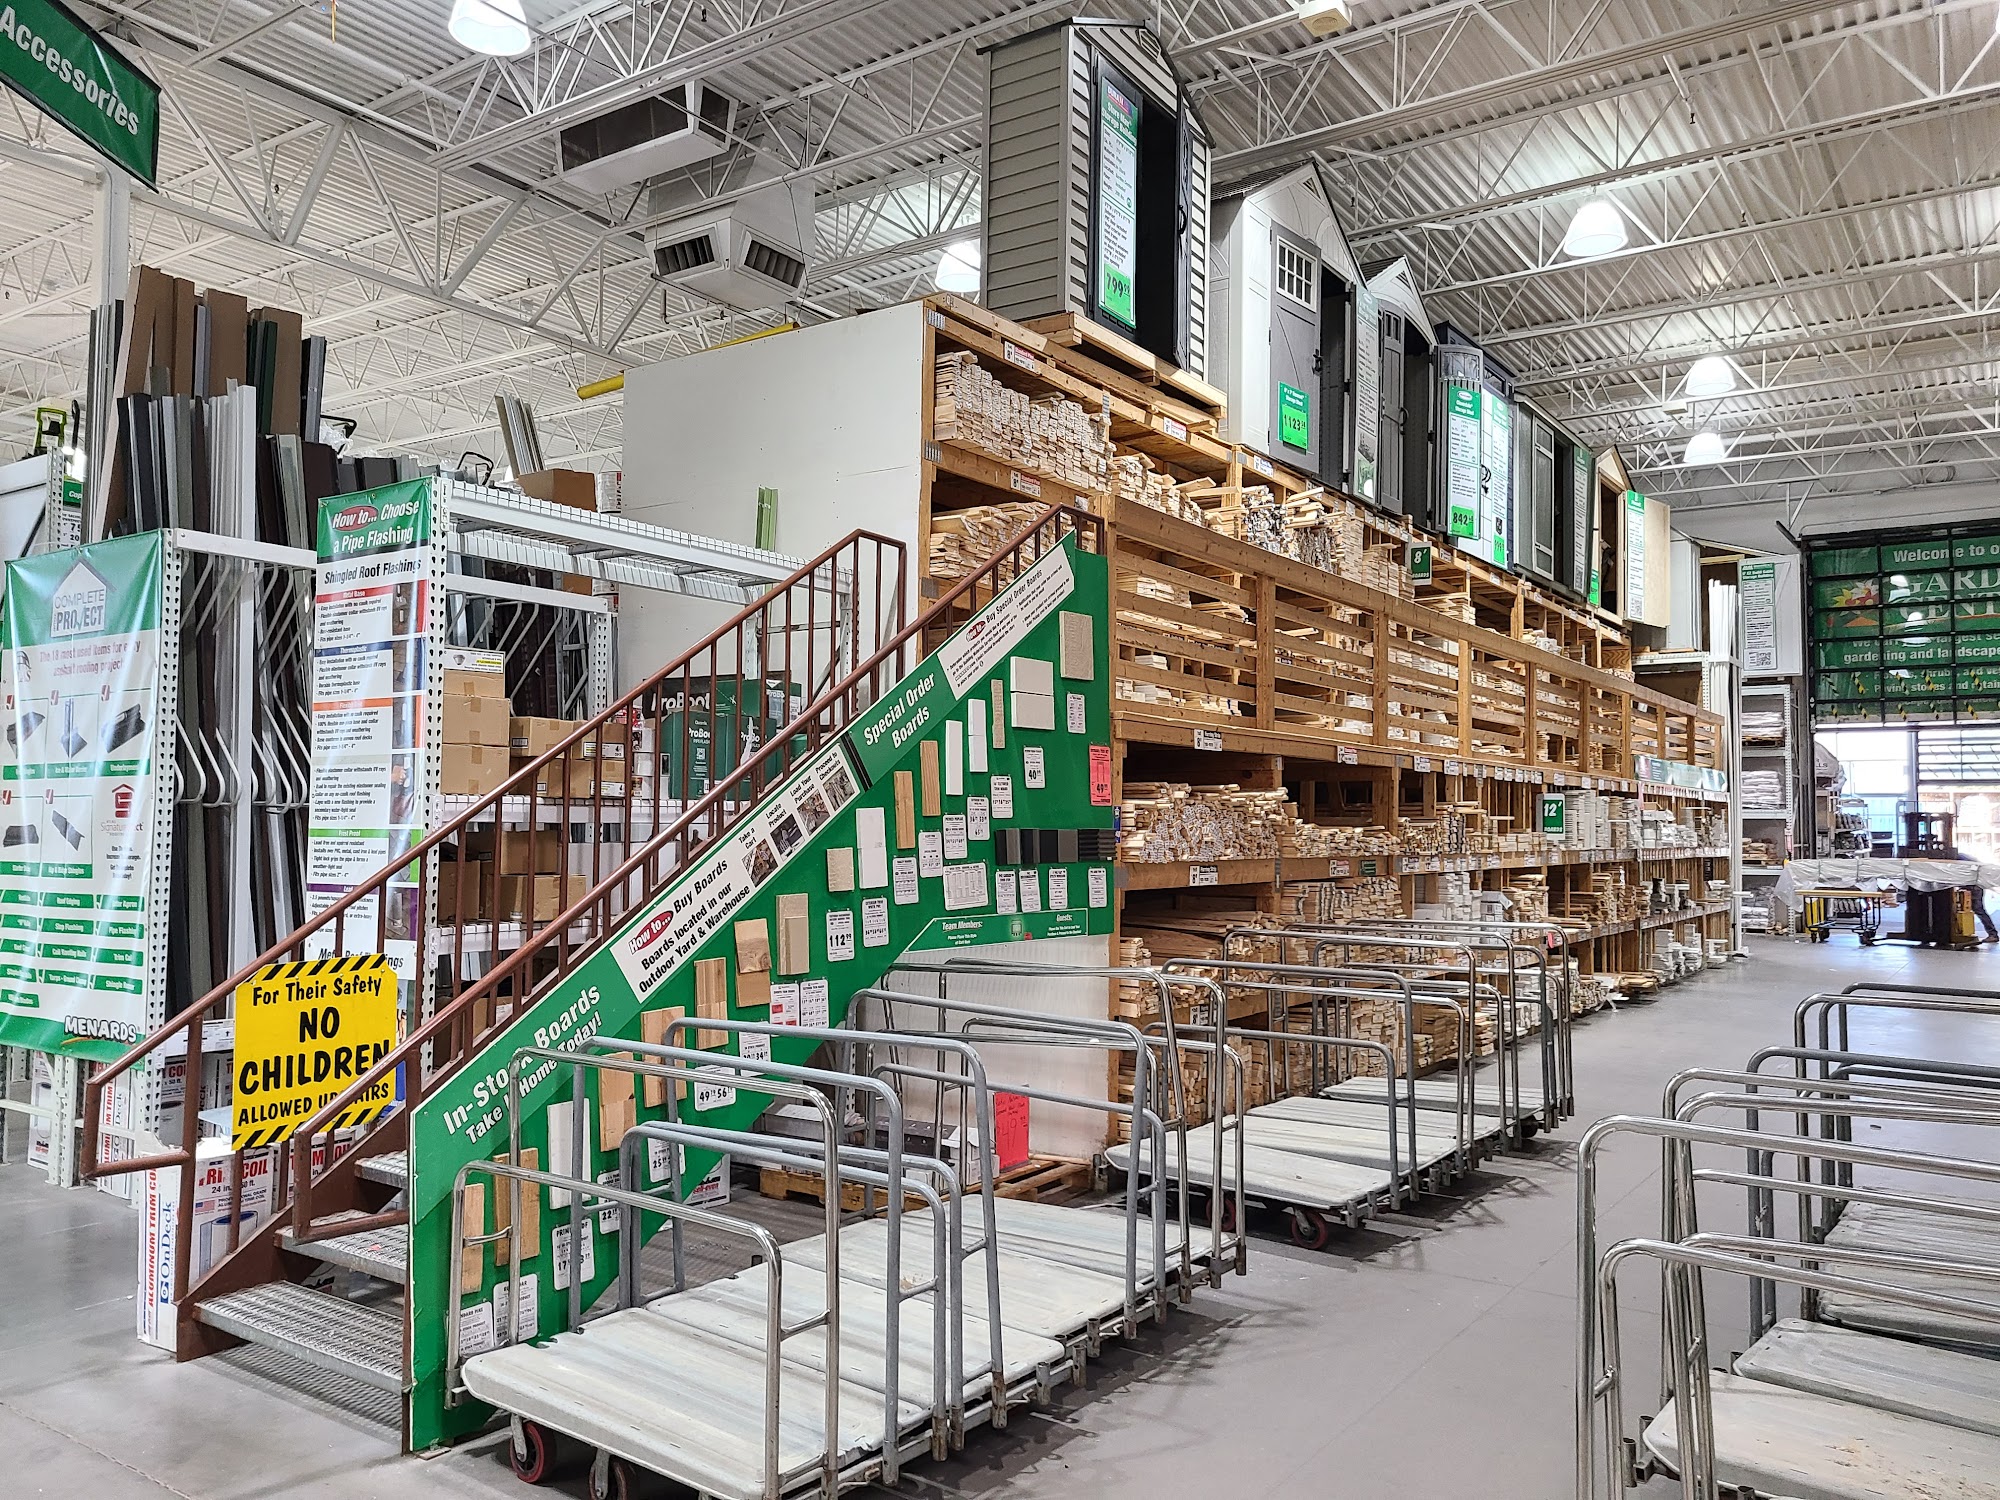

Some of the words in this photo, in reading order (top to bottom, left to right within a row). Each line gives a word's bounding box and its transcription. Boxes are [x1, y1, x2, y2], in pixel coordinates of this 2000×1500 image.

[0, 5, 139, 135] Accessories
[332, 511, 356, 529] How
[357, 509, 377, 525] to...
[380, 500, 420, 521] Choose
[334, 541, 339, 553] a
[341, 535, 364, 553] Pipe
[367, 525, 414, 547] Flashing
[1893, 548, 1964, 563] Welcome
[1969, 544, 1985, 556] to
[324, 568, 357, 584] Shingled
[359, 562, 380, 579] Roof
[383, 558, 421, 575] Flashings
[54, 589, 105, 610] COMPLETE
[986, 612, 995, 623] Buy
[996, 594, 1013, 615] Special
[1014, 584, 1026, 599] Order
[1027, 569, 1043, 587] Boards
[1910, 648, 1933, 660] and
[1938, 646, 2000, 658] ladscape
[651, 691, 710, 711] roBoot
[863, 698, 906, 746] Special
[905, 672, 936, 708] Order
[892, 705, 930, 749] Boards
[815, 756, 833, 774] Proceed
[789, 784, 801, 797] Load
[801, 775, 812, 786] Your
[794, 784, 815, 804] Purchase
[765, 803, 782, 819] Locate
[768, 809, 787, 828] Product
[1543, 801, 1563, 817] 12'
[738, 831, 751, 844] Take
[745, 837, 757, 849] Cart
[628, 930, 652, 956] How
[650, 914, 672, 935] to...
[673, 890, 693, 915] Buy
[694, 858, 728, 896] Boards
[638, 956, 676, 994] Outdoor
[675, 933, 698, 959] Yard
[699, 924, 706, 938] &
[705, 884, 751, 930] Warehouse
[640, 936, 675, 971] Boards
[674, 909, 708, 941] located
[707, 899, 718, 913] in
[717, 882, 733, 903] our
[942, 921, 957, 931] Team
[252, 986, 279, 1007] For
[286, 980, 327, 1002] Their
[333, 974, 382, 997] Safety
[64, 1015, 137, 1043] MENARDS
[299, 1006, 340, 1043] NO
[238, 1039, 390, 1096] CHILDREN
[442, 1053, 533, 1135] In-Stok
[533, 985, 601, 1049] Boards
[465, 1105, 504, 1145] Take
[519, 1059, 558, 1098] Home
[557, 1011, 602, 1053] Today!
[238, 1097, 313, 1127] ALLOWED
[318, 1082, 389, 1109] UPAIRS
[242, 1159, 268, 1178] COIL
[149, 1194, 157, 1228] TRIM
[161, 1202, 172, 1279] OnDeck
[148, 1232, 157, 1308] ALUMINUM
